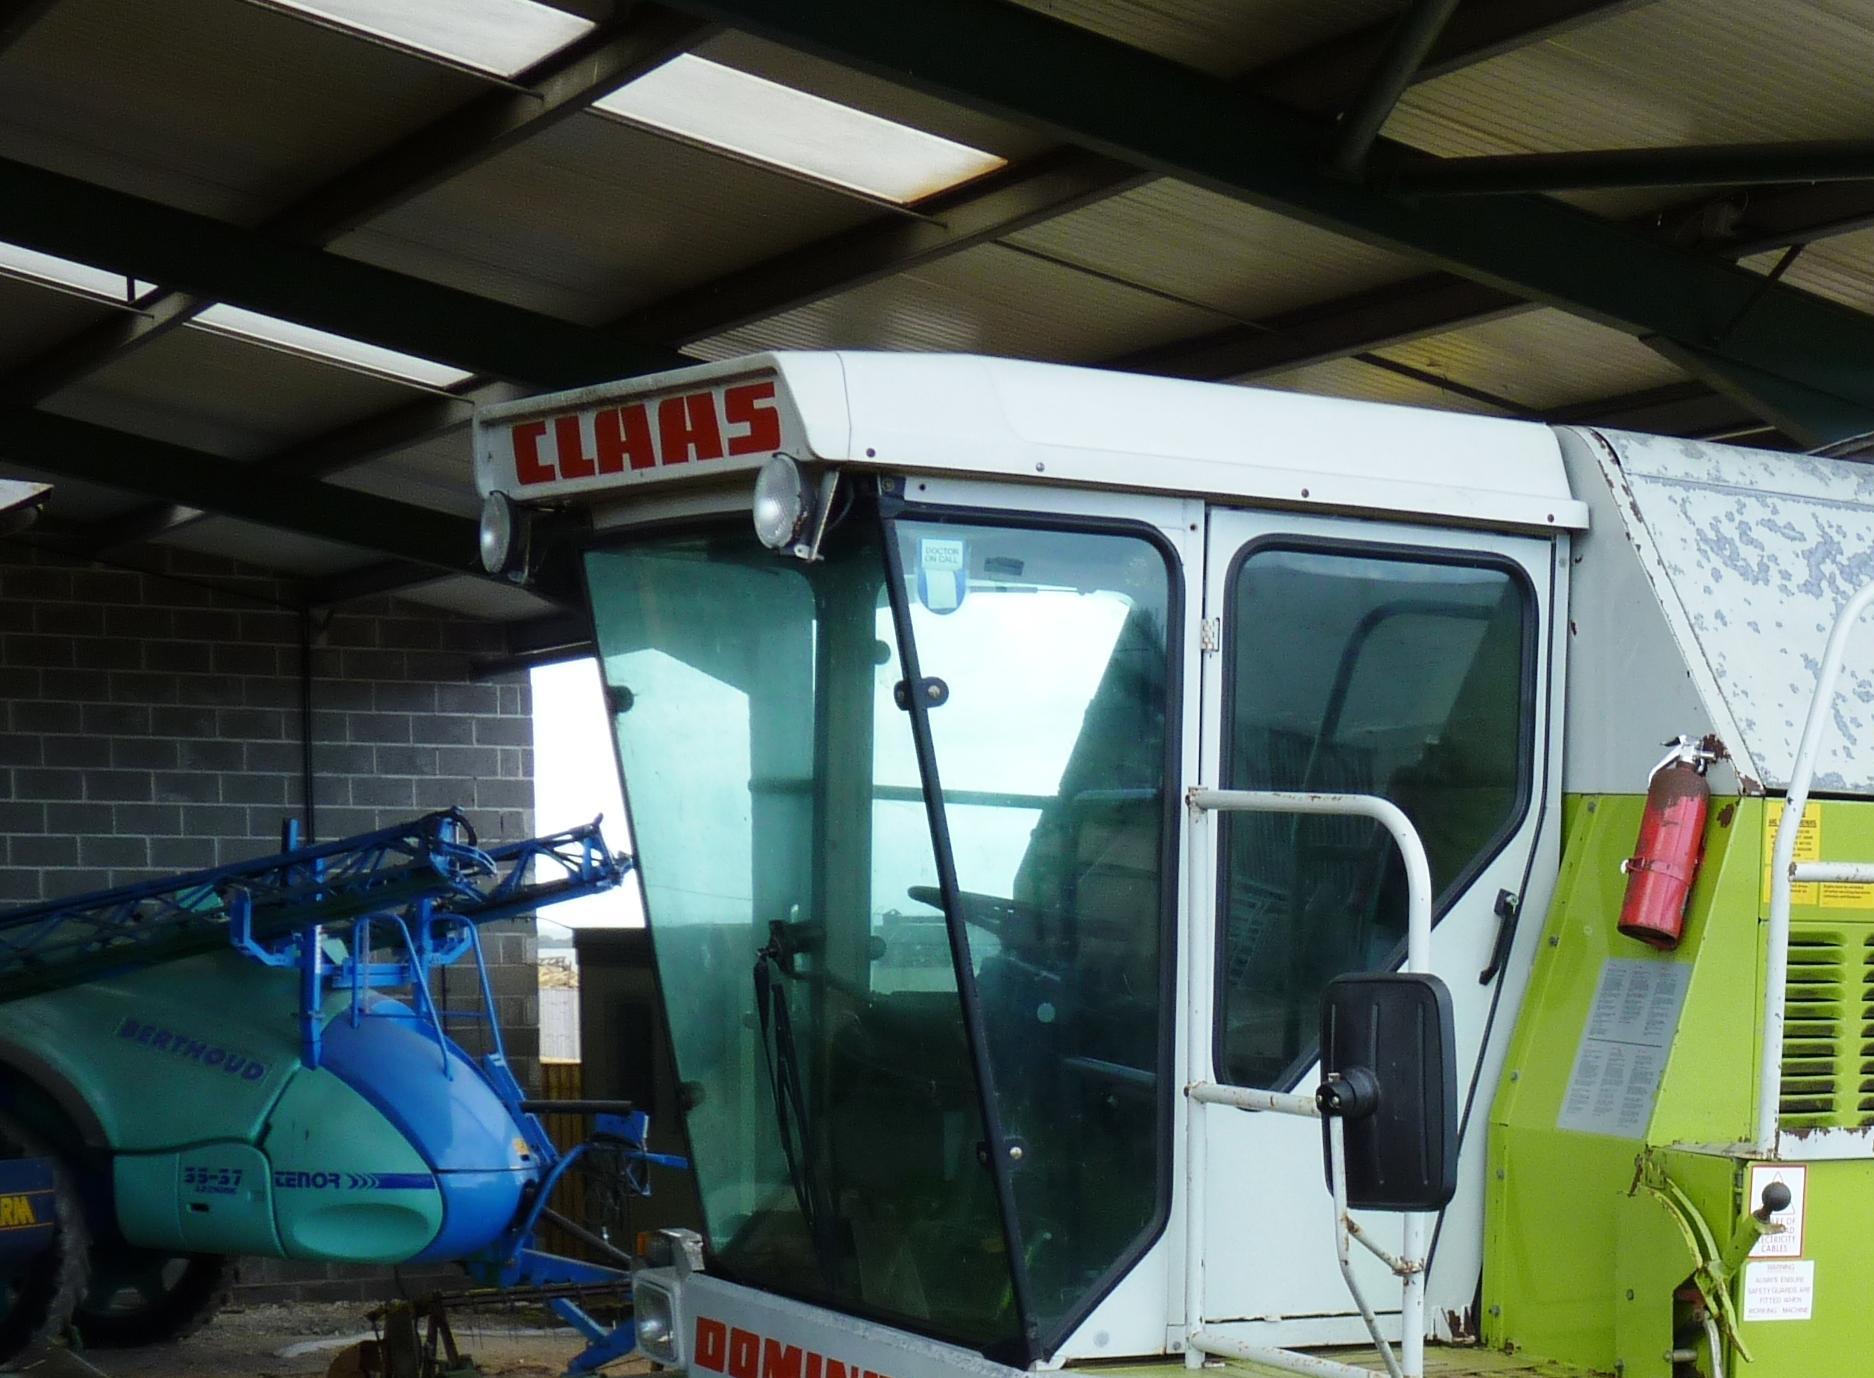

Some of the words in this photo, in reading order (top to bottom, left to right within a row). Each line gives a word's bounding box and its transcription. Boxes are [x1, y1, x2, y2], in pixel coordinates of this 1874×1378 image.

[512, 381, 781, 485] CLAAS
[120, 1016, 265, 1082] BERTHOUD
[274, 1170, 341, 1189] TENOR
